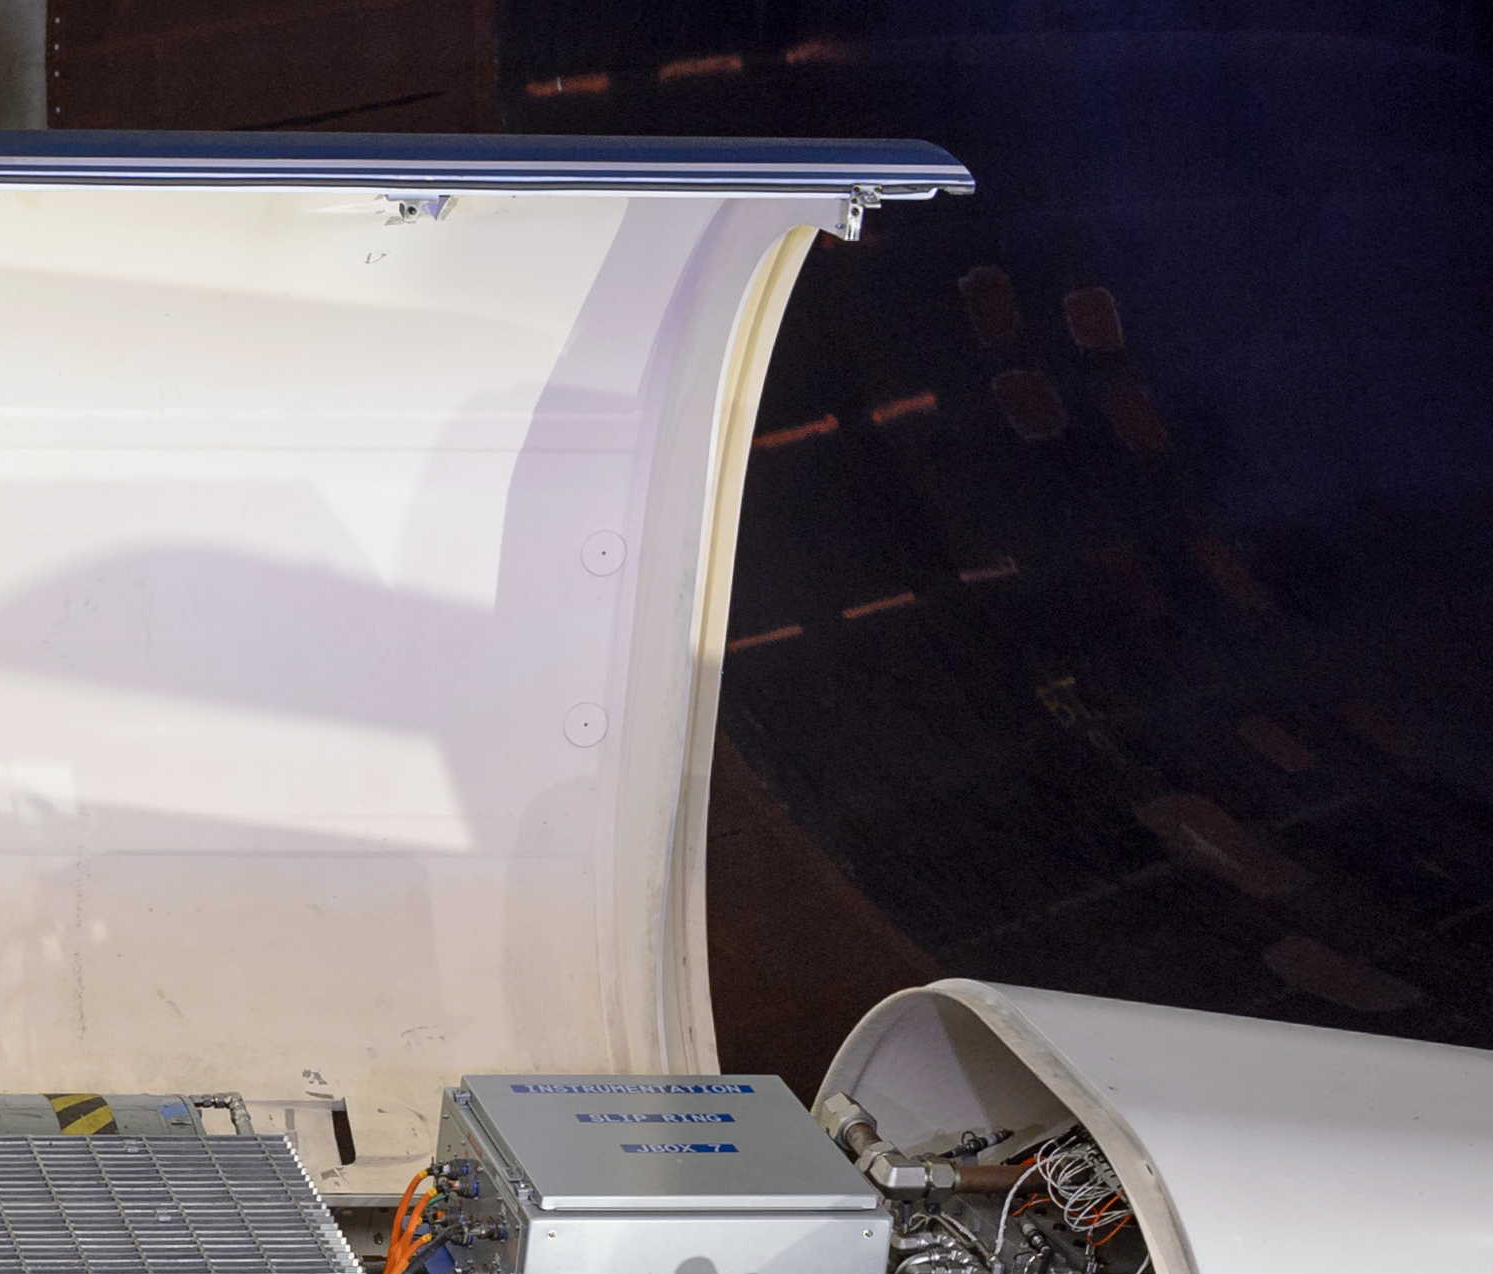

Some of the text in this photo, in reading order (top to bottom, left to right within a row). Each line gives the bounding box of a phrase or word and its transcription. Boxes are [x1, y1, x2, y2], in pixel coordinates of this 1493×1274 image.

[525, 1084, 744, 1094] INSTRUMENTATION
[588, 1113, 723, 1123] SLIP RING
[635, 1143, 723, 1153] JBOX 7
